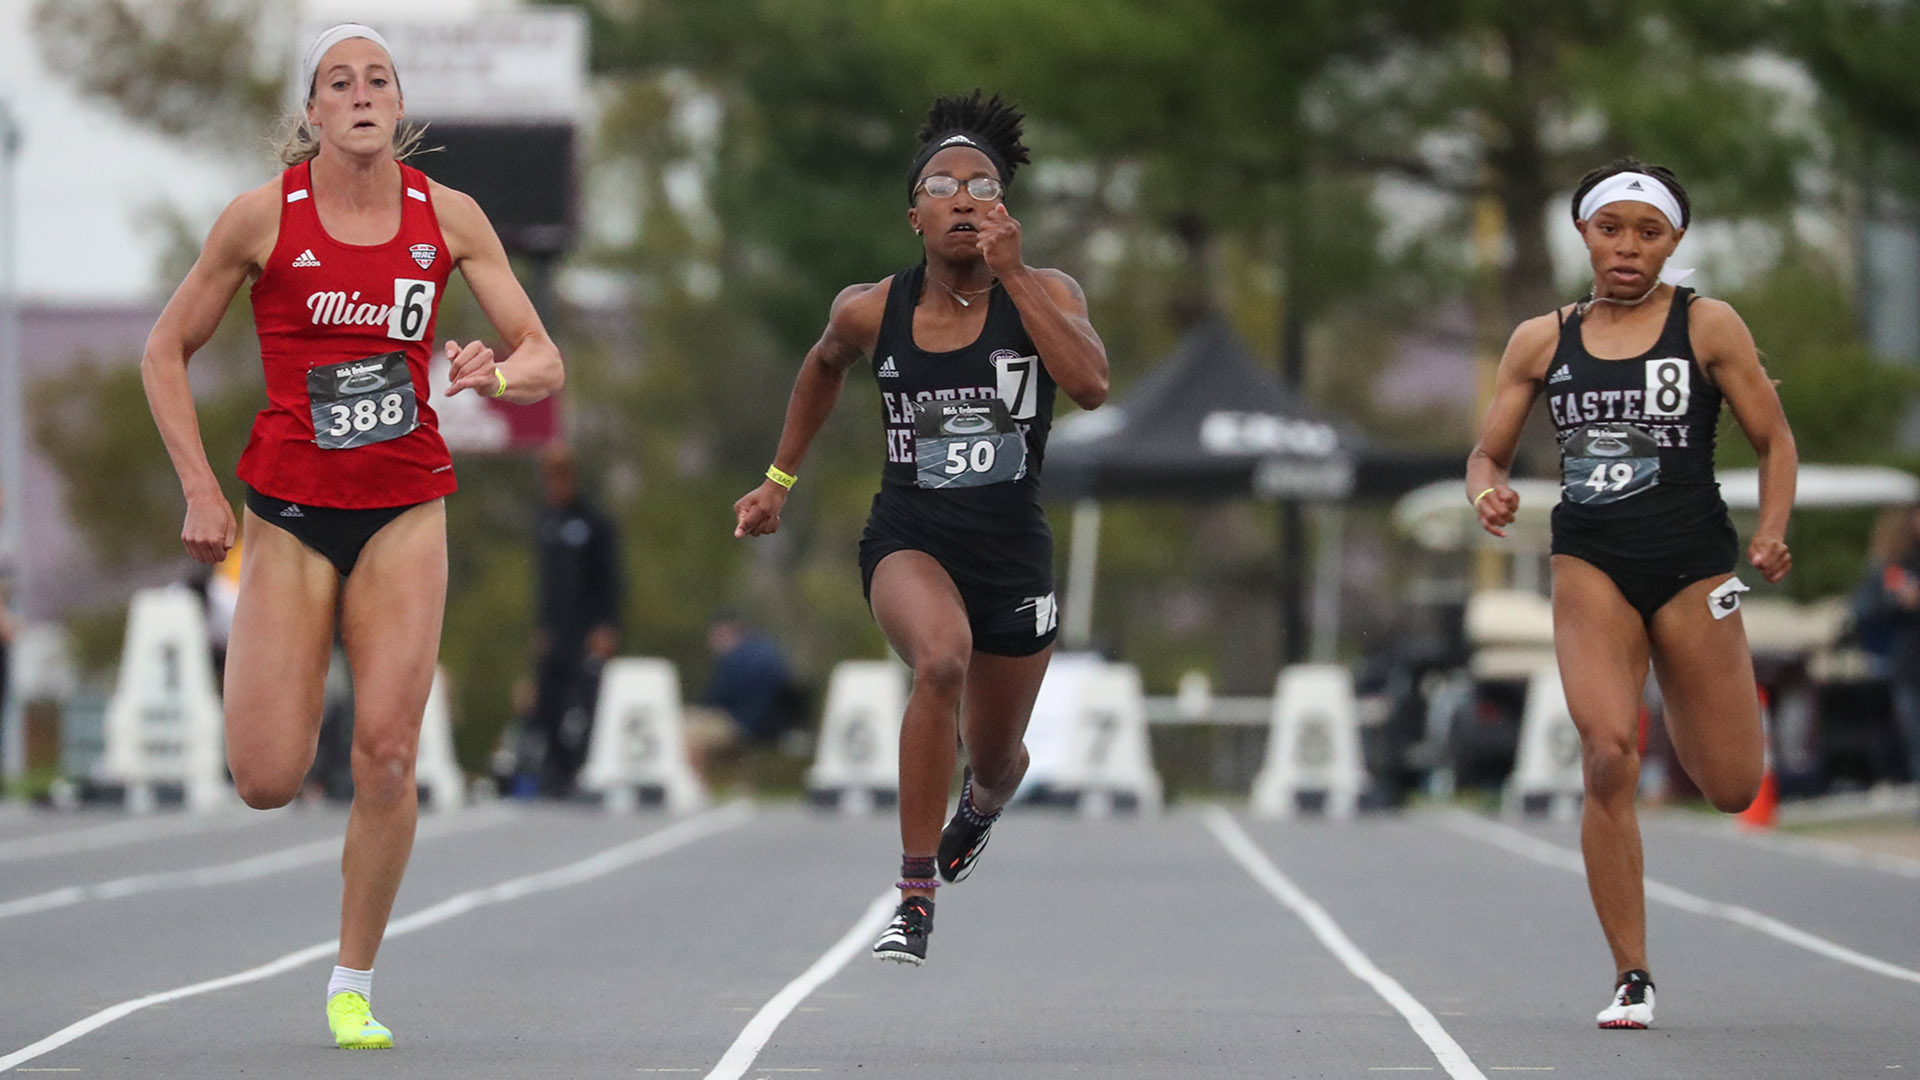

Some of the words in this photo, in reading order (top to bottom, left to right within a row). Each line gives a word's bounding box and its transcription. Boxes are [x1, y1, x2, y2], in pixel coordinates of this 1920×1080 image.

[292, 260, 321, 268] adidas
[411, 251, 436, 259] MAC
[400, 283, 426, 338] 6
[878, 370, 900, 378] adidas
[1006, 361, 1031, 416] 7
[1656, 361, 1681, 413] 8
[329, 393, 404, 437] 388
[944, 440, 996, 475] 50
[1585, 462, 1634, 492] 49
[621, 707, 656, 755] 5
[841, 709, 877, 759] 6
[1083, 711, 1117, 758] 7
